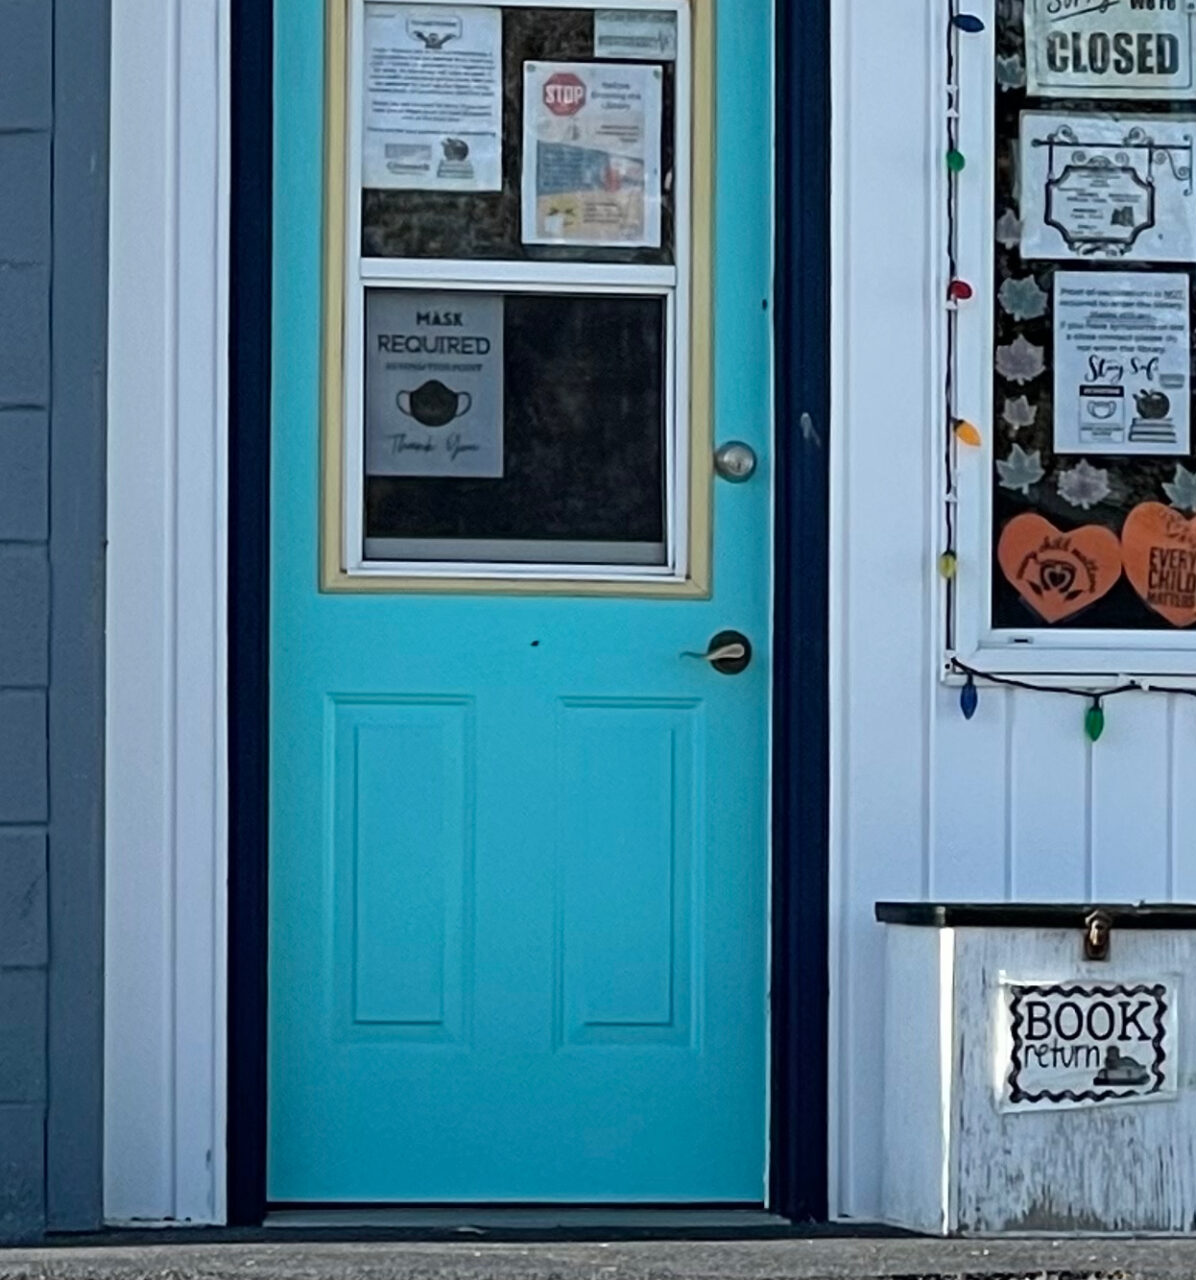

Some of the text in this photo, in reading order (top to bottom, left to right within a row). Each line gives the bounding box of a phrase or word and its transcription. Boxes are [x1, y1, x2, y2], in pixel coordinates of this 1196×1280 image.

[1046, 31, 1180, 76] CLOSED
[545, 84, 584, 105] STOP
[416, 311, 463, 326] MASK
[377, 334, 491, 355] REQUIRED
[1084, 354, 1124, 385] Stay
[1148, 568, 1196, 593] CHILD
[1024, 1001, 1153, 1041] BOOK
[1023, 1038, 1100, 1069] return
